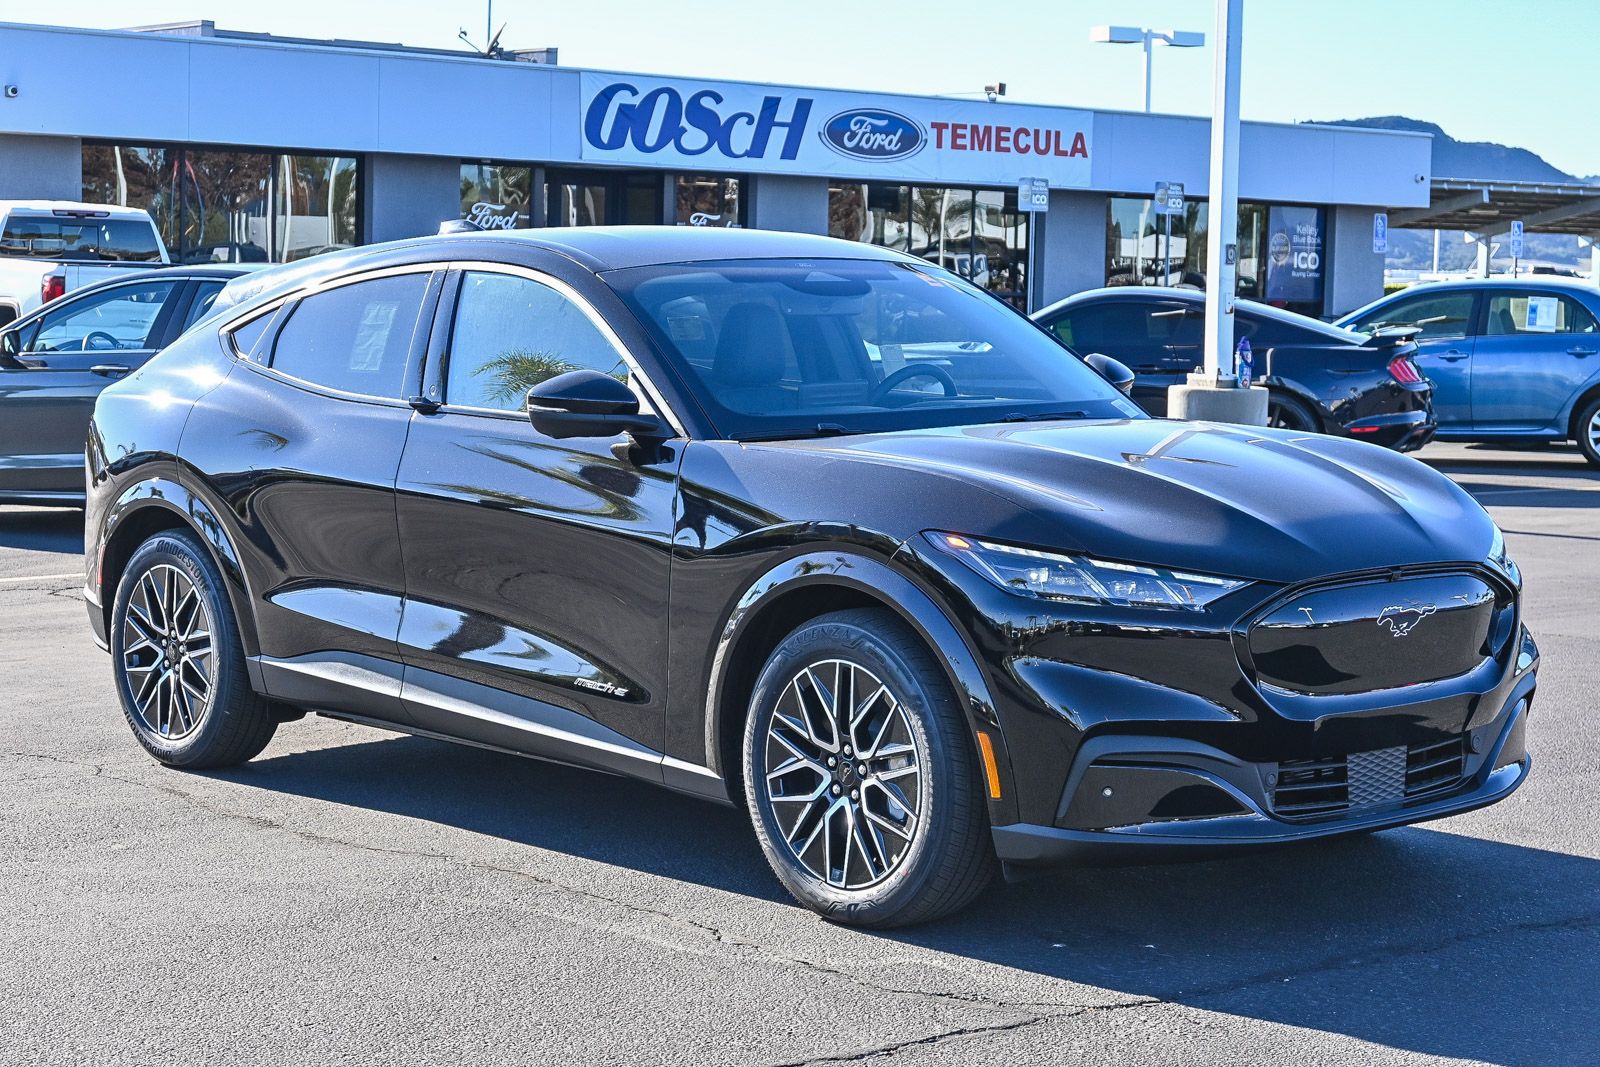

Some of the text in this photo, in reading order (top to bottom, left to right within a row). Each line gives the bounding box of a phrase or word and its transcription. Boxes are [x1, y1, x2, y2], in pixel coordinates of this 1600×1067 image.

[843, 115, 903, 151] Ford
[930, 121, 1089, 158] TEMECULA
[1032, 194, 1047, 204] ICO
[1168, 198, 1183, 208] ICO
[466, 202, 518, 230] Ford
[1296, 223, 1319, 236] Kelley
[1293, 251, 1320, 270] ICO
[156, 540, 209, 595] BRIDGESTONE
